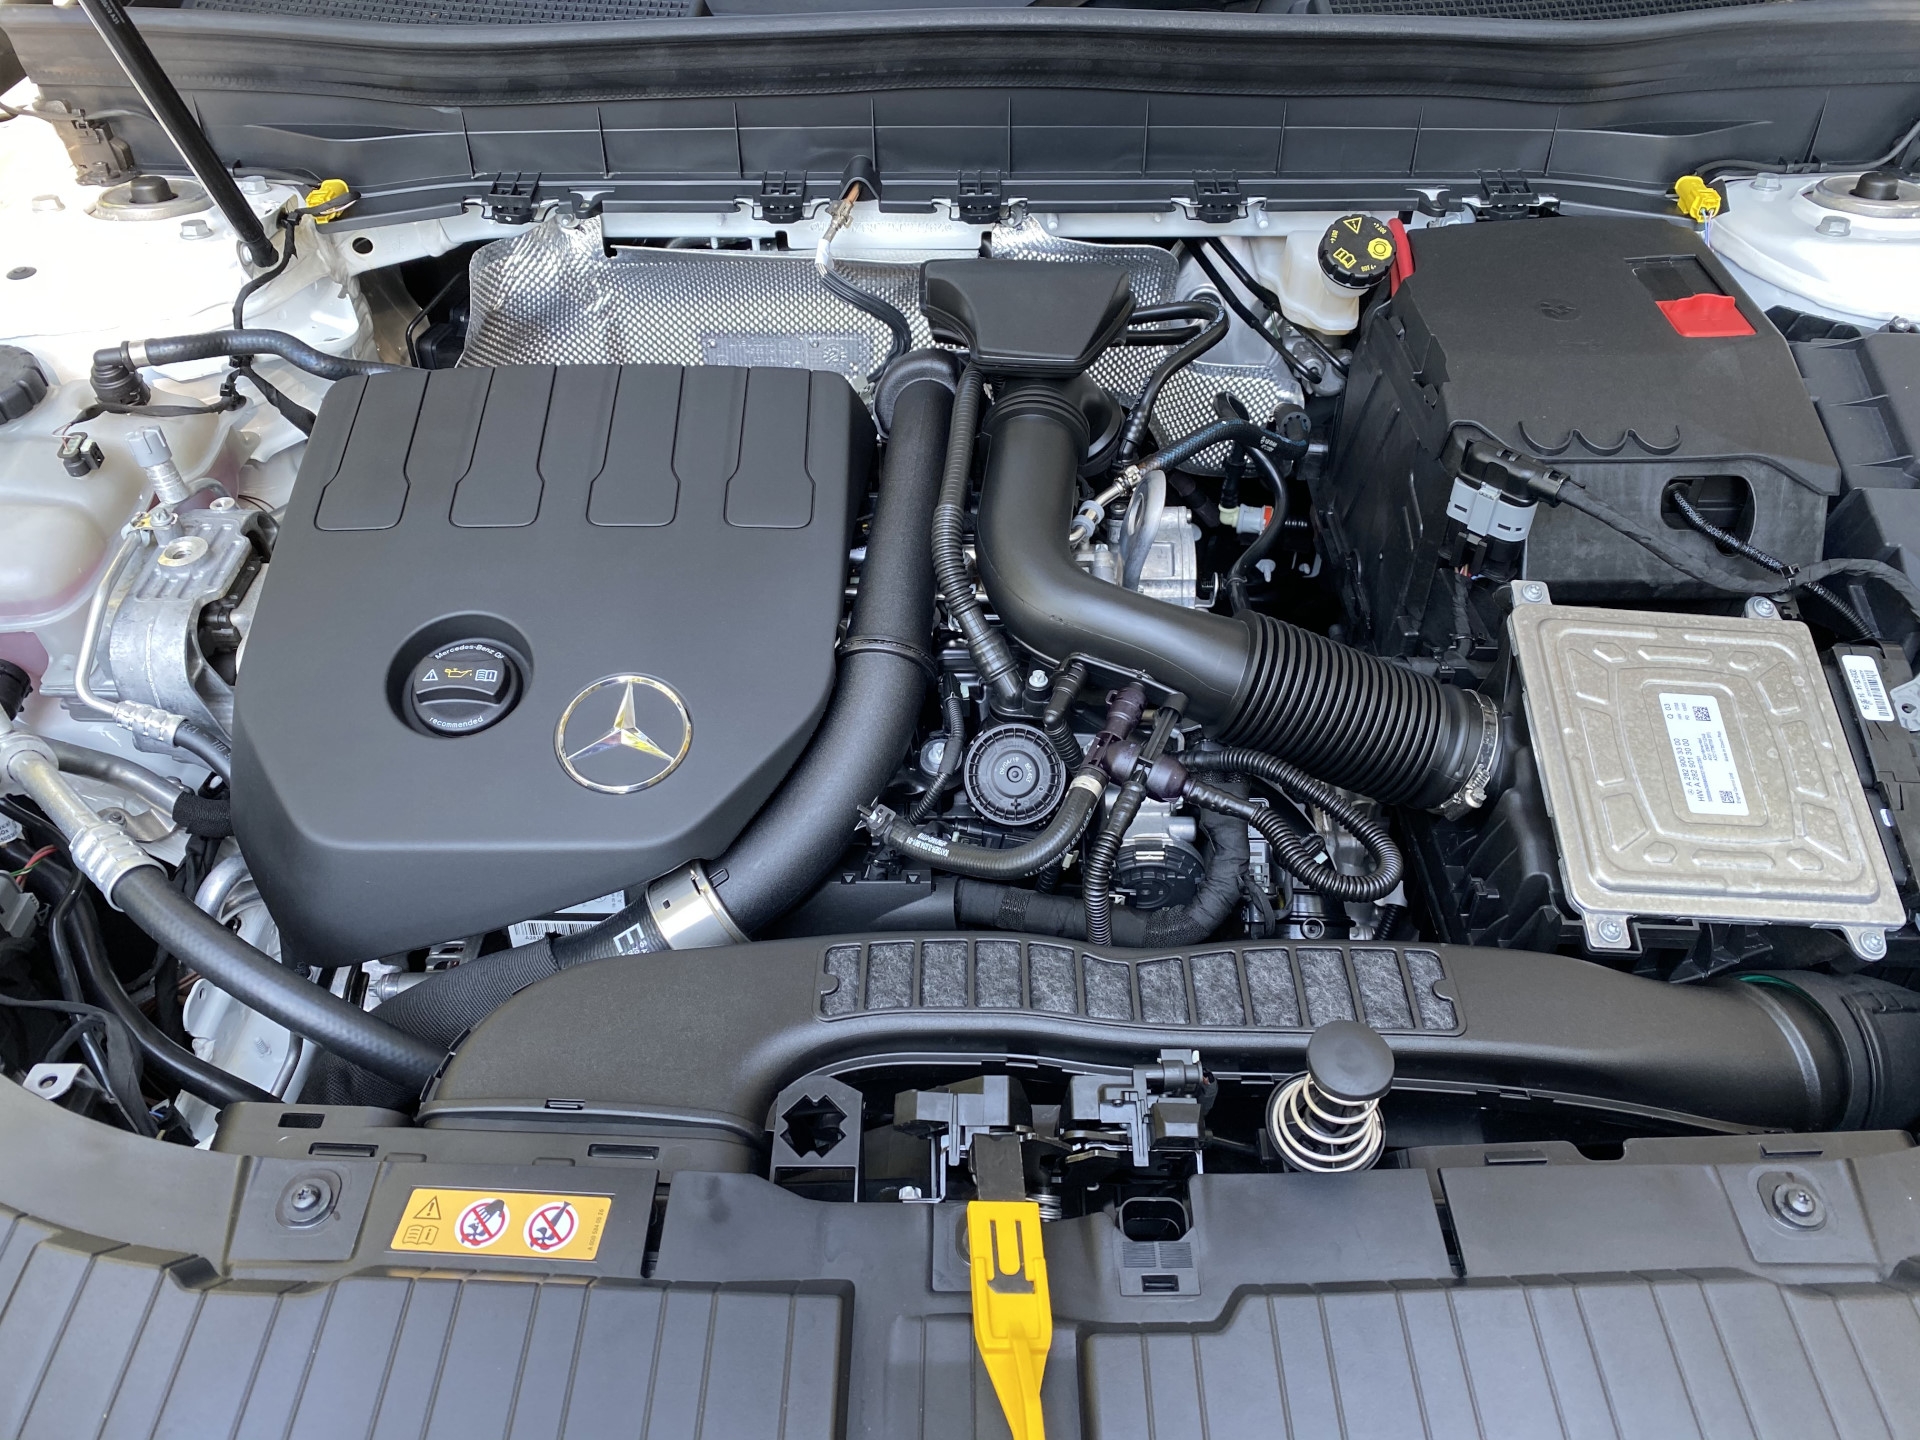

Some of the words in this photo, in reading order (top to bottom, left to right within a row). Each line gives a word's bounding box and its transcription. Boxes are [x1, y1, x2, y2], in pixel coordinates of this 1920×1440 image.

[435, 644, 494, 660] Mercedes-Benz
[429, 715, 484, 728] recommended
[1678, 756, 1687, 767] 900
[1687, 757, 1696, 768] 901
[1682, 769, 1690, 780] 282
[1691, 770, 1699, 781] 282
